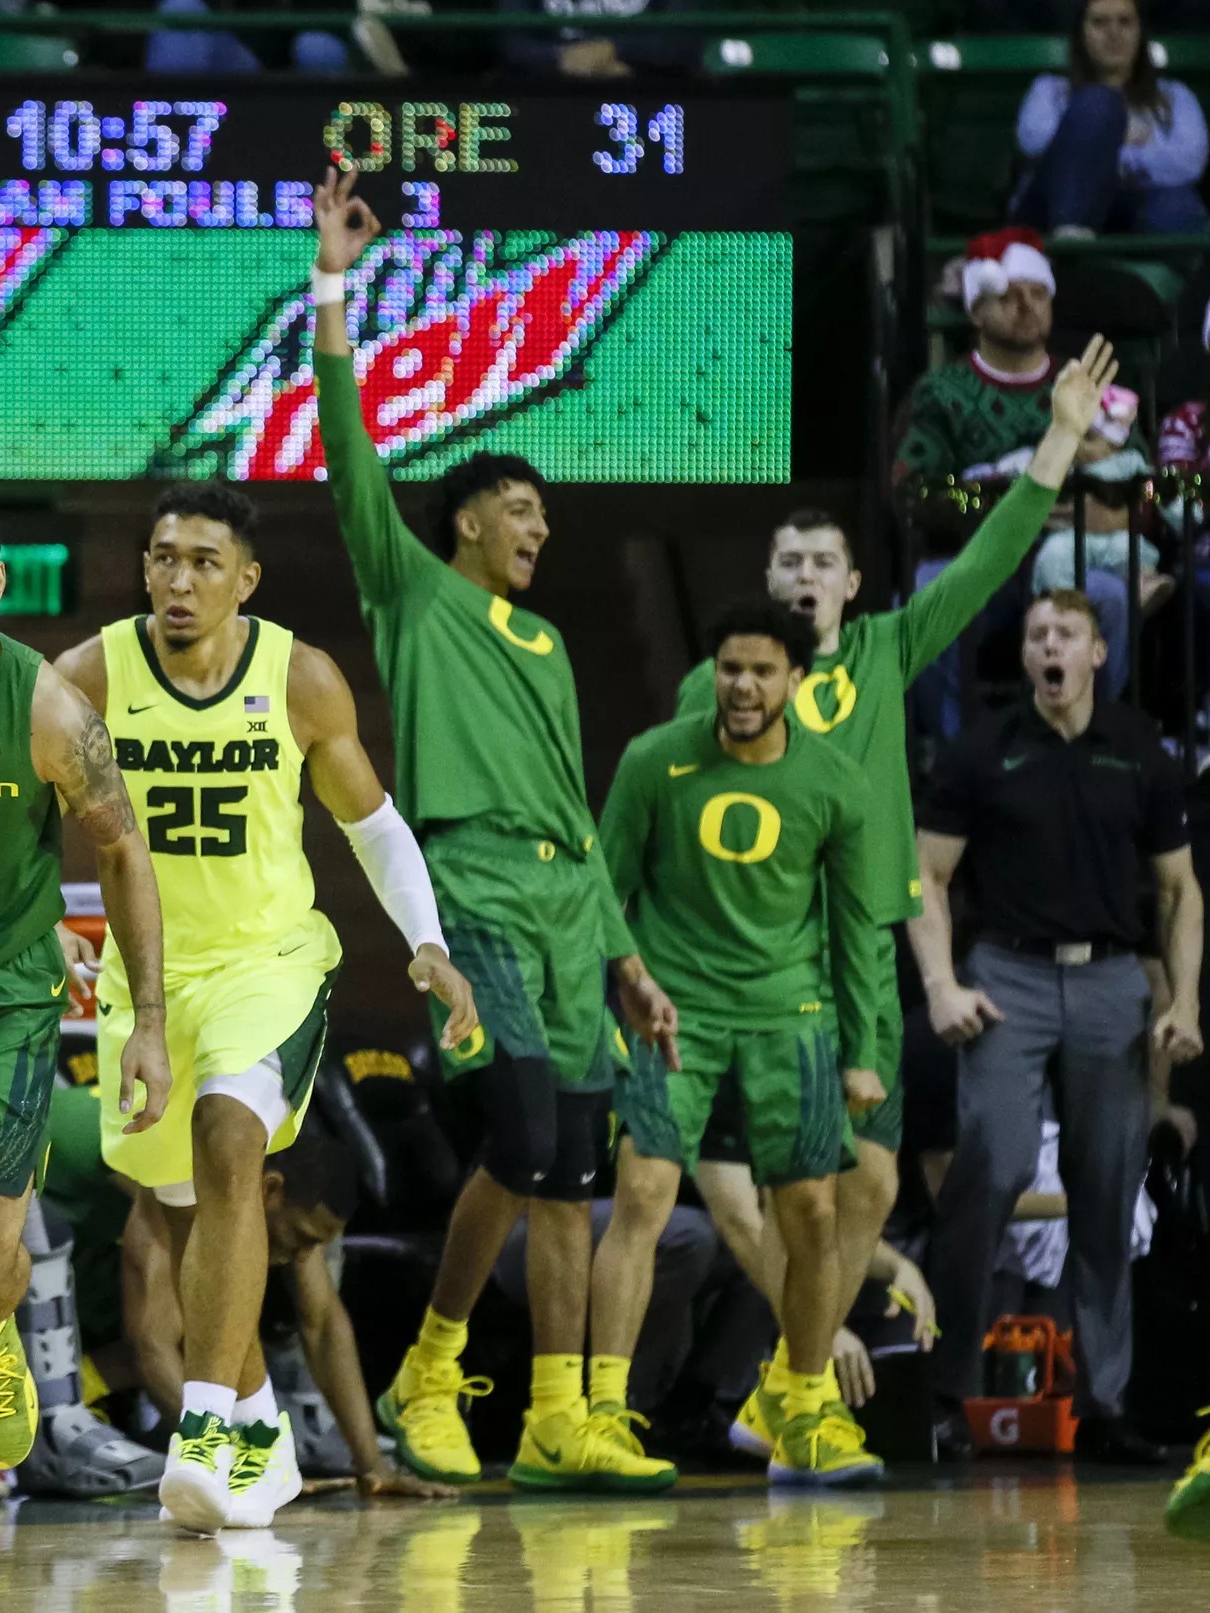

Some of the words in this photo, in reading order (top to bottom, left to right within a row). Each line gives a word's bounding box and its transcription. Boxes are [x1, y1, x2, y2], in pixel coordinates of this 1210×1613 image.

[7, 100, 227, 172] 10:57
[323, 101, 519, 173] ORE
[593, 103, 685, 174] 31
[109, 181, 313, 227] FOULS
[115, 738, 279, 773] BAYLOR
[146, 786, 249, 857] 25
[699, 792, 782, 864] O
